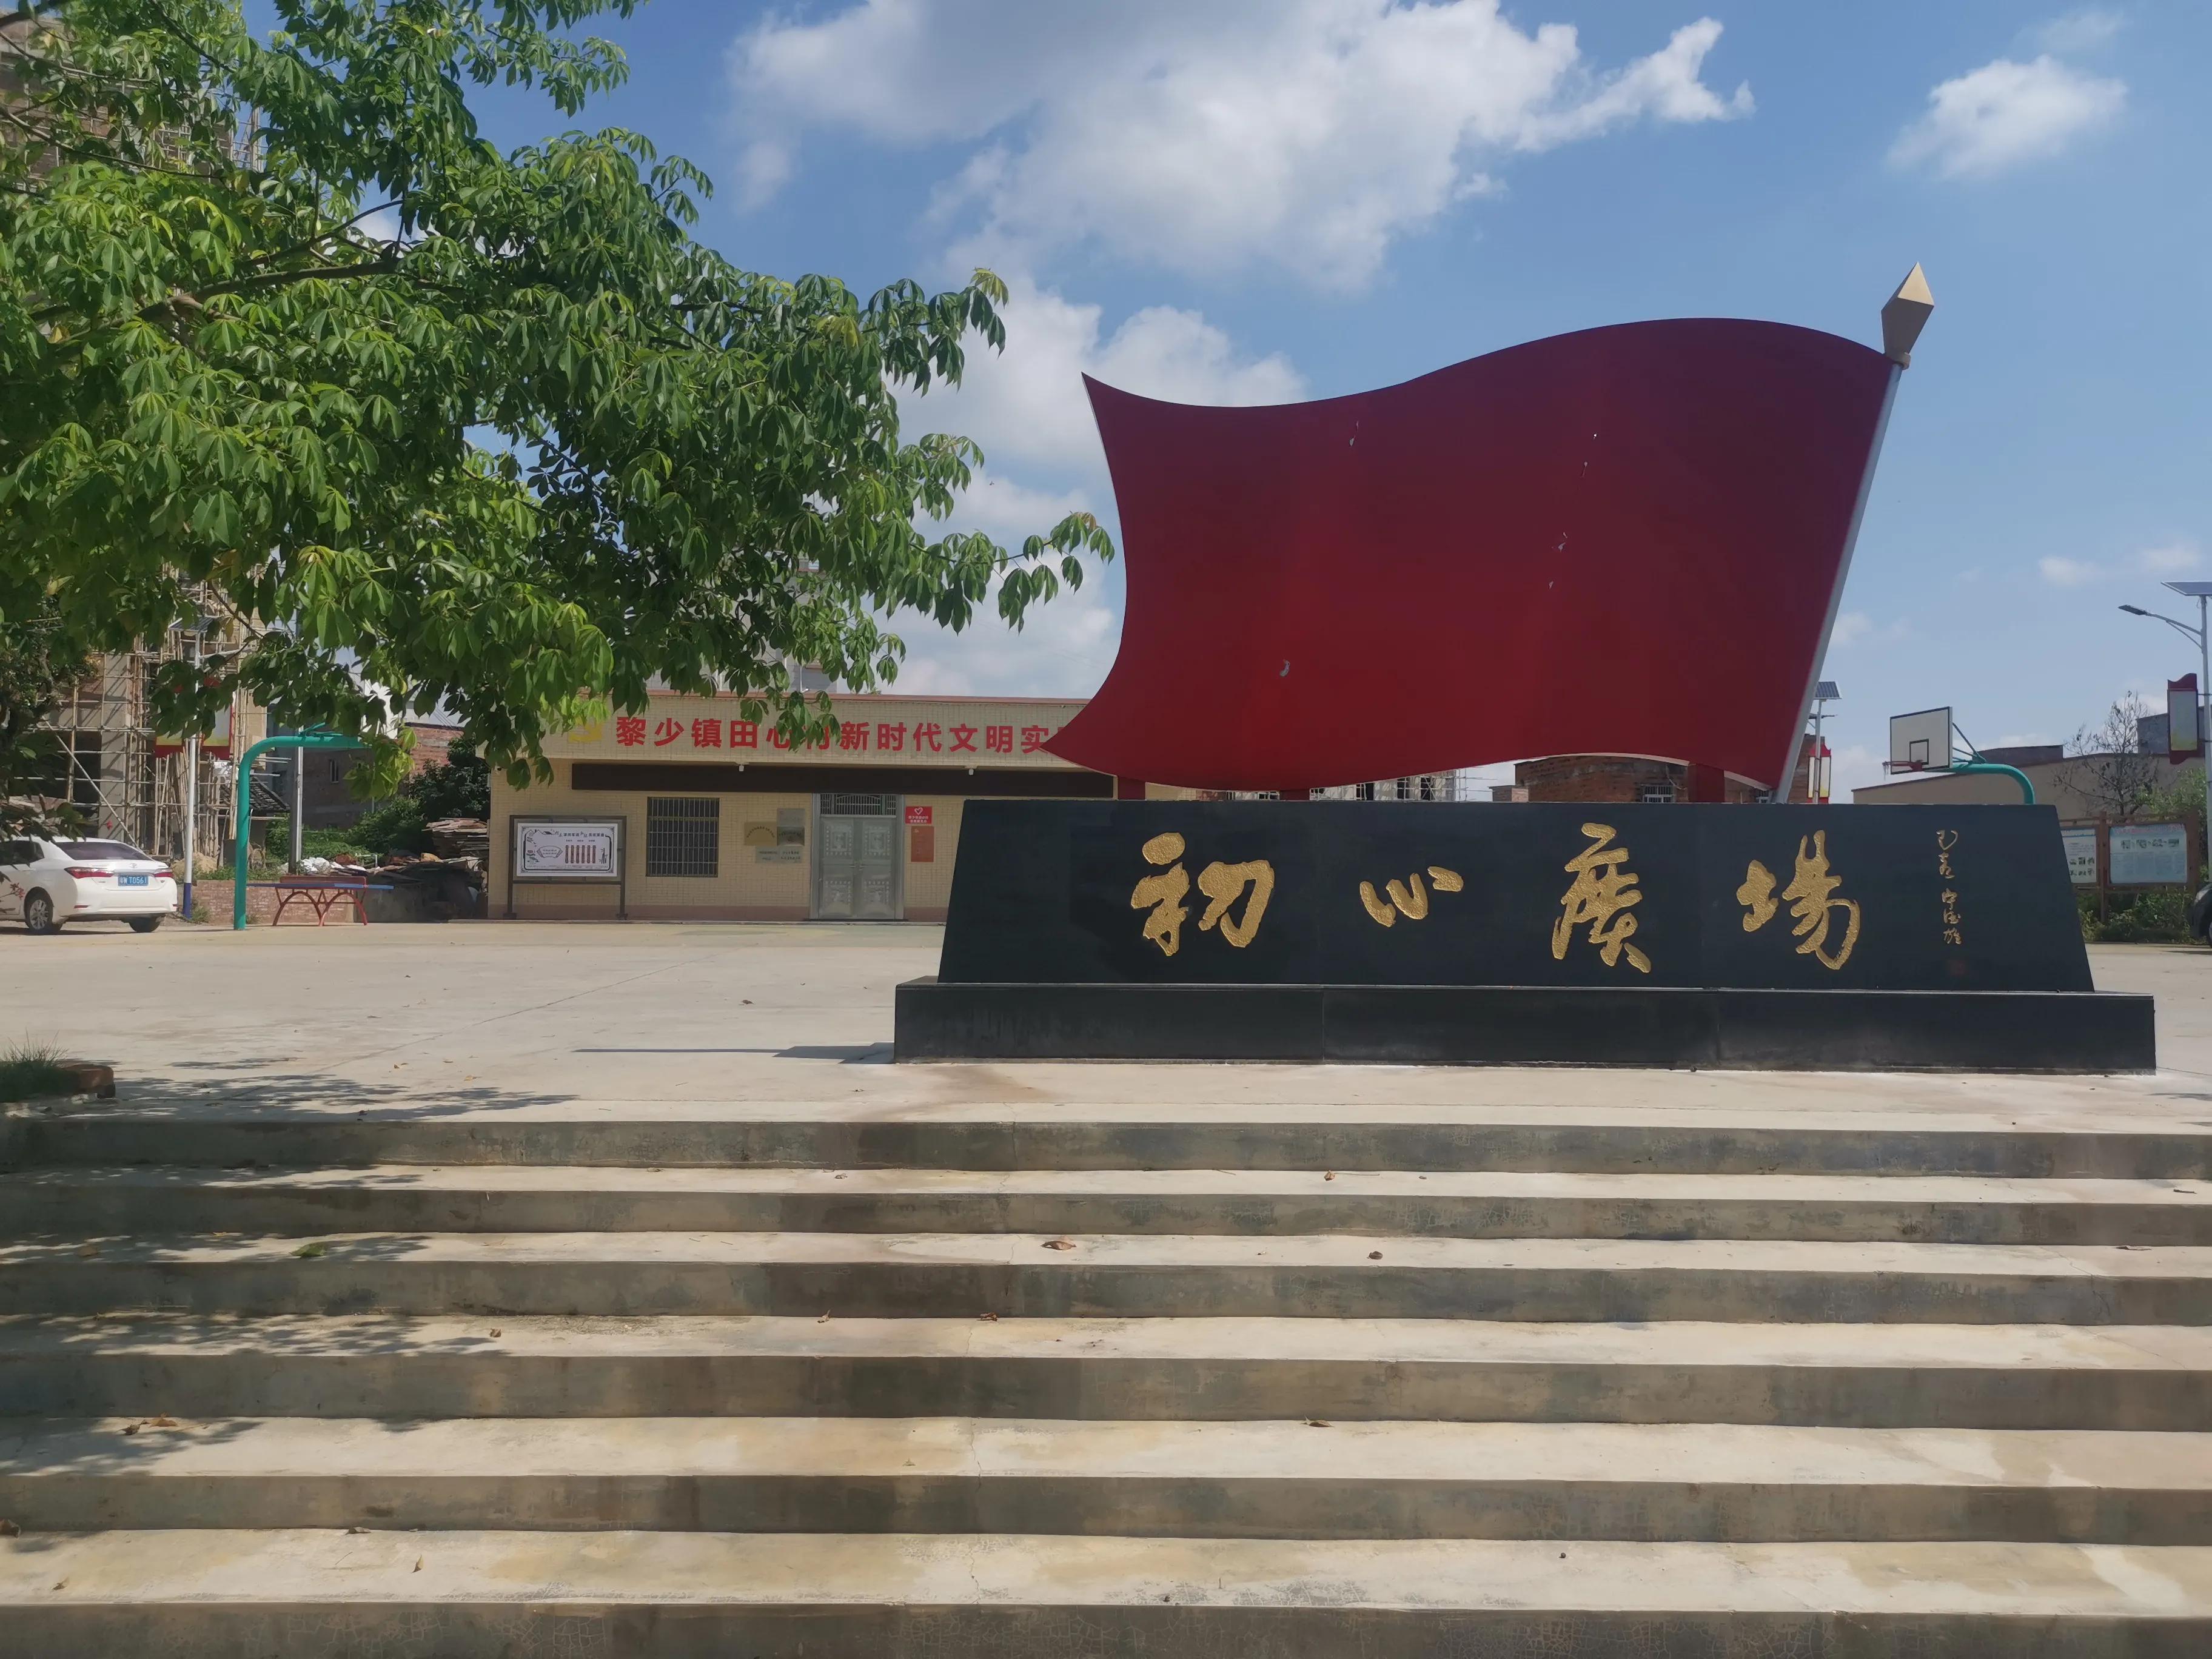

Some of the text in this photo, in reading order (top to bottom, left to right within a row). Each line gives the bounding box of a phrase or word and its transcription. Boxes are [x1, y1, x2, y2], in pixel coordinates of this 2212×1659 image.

[616, 717, 1064, 754] 黎少镇田心新时代文明实
